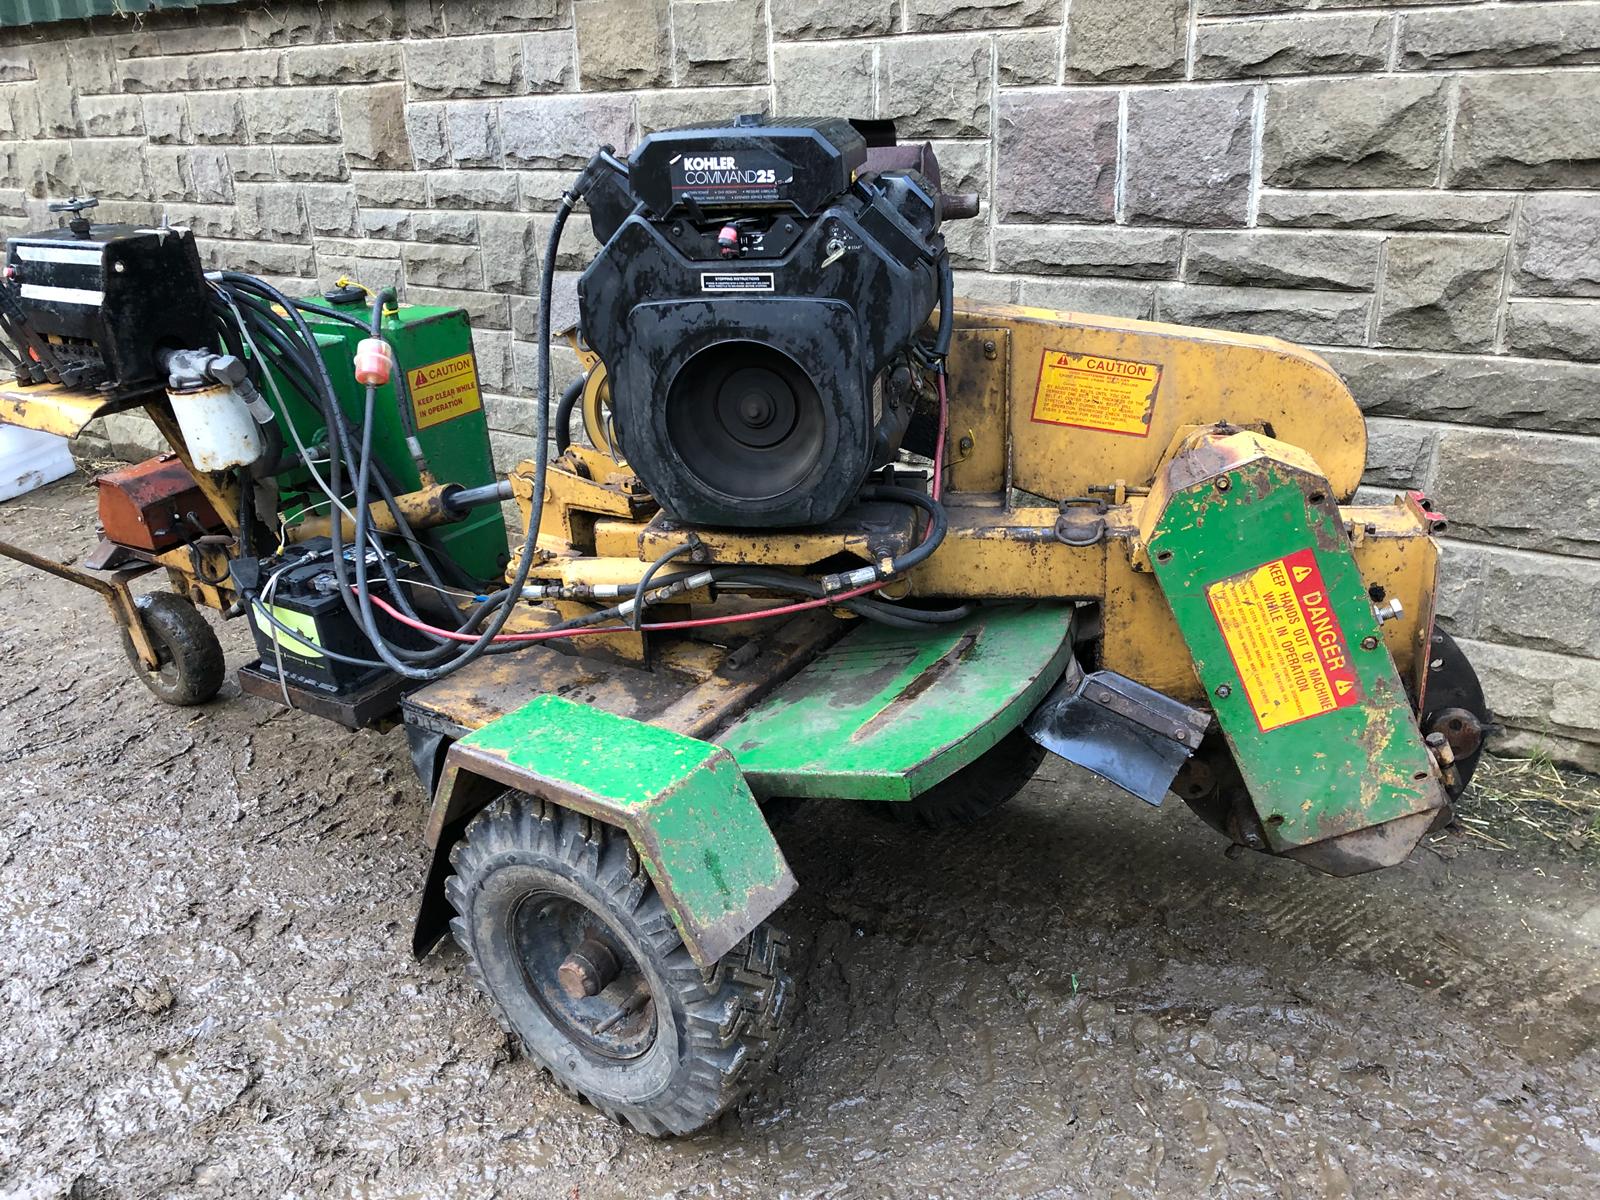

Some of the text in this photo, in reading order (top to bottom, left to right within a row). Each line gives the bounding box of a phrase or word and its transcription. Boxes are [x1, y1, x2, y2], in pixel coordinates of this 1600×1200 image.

[684, 157, 736, 171] KOHLER
[429, 359, 470, 379] CAUTION
[1087, 359, 1147, 376] CAUTION
[417, 381, 475, 406] KEEP CLEAR WHILE
[428, 398, 463, 415] OPERATION
[1262, 591, 1310, 693] WHILE IN OPERATION
[1268, 563, 1332, 710] KEEP HANDS OUT OF MACHINE
[1302, 591, 1346, 671] DANGER
